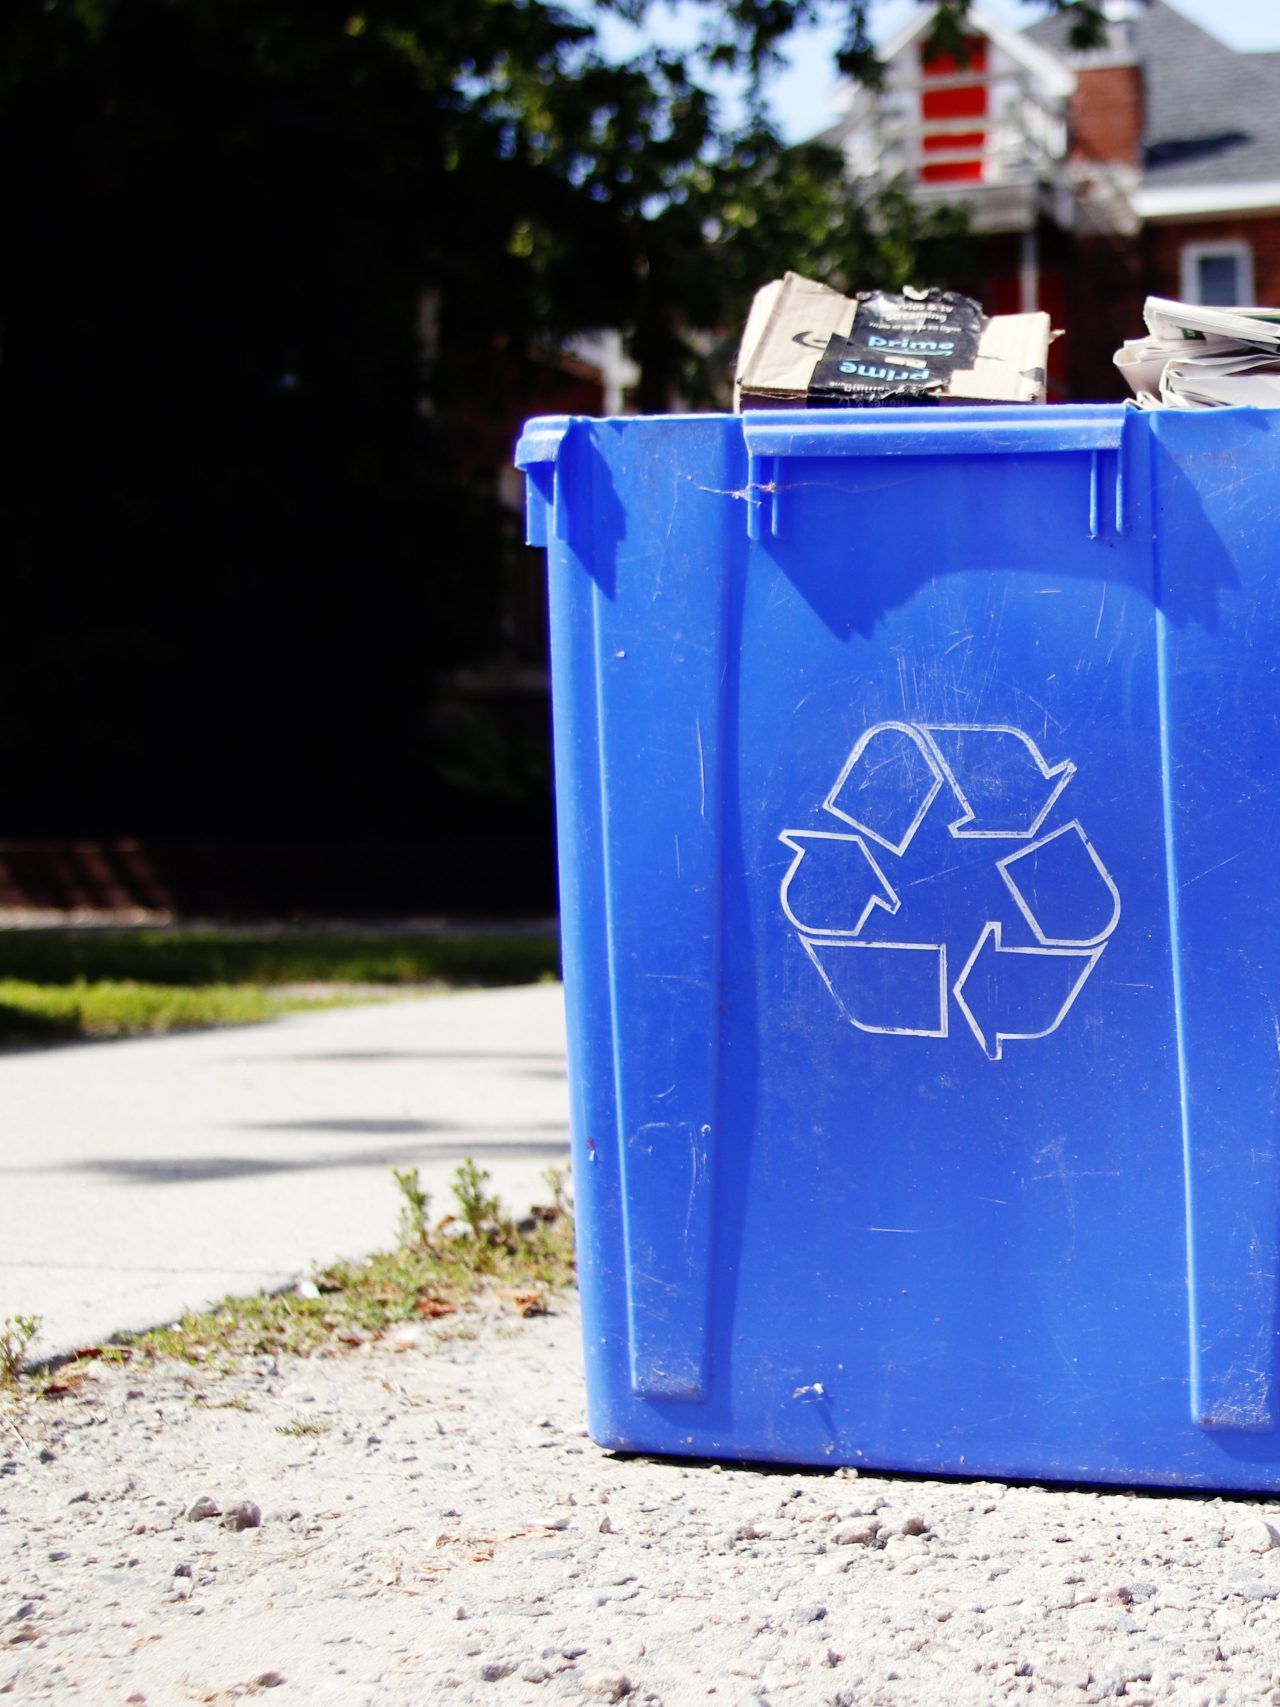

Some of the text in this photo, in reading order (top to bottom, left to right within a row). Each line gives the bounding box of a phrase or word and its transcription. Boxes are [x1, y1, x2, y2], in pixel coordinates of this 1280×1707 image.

[927, 303, 937, 311] &
[939, 304, 954, 313] tv
[884, 311, 947, 323] streaming
[867, 335, 955, 350] prime
[838, 361, 930, 382] prime
